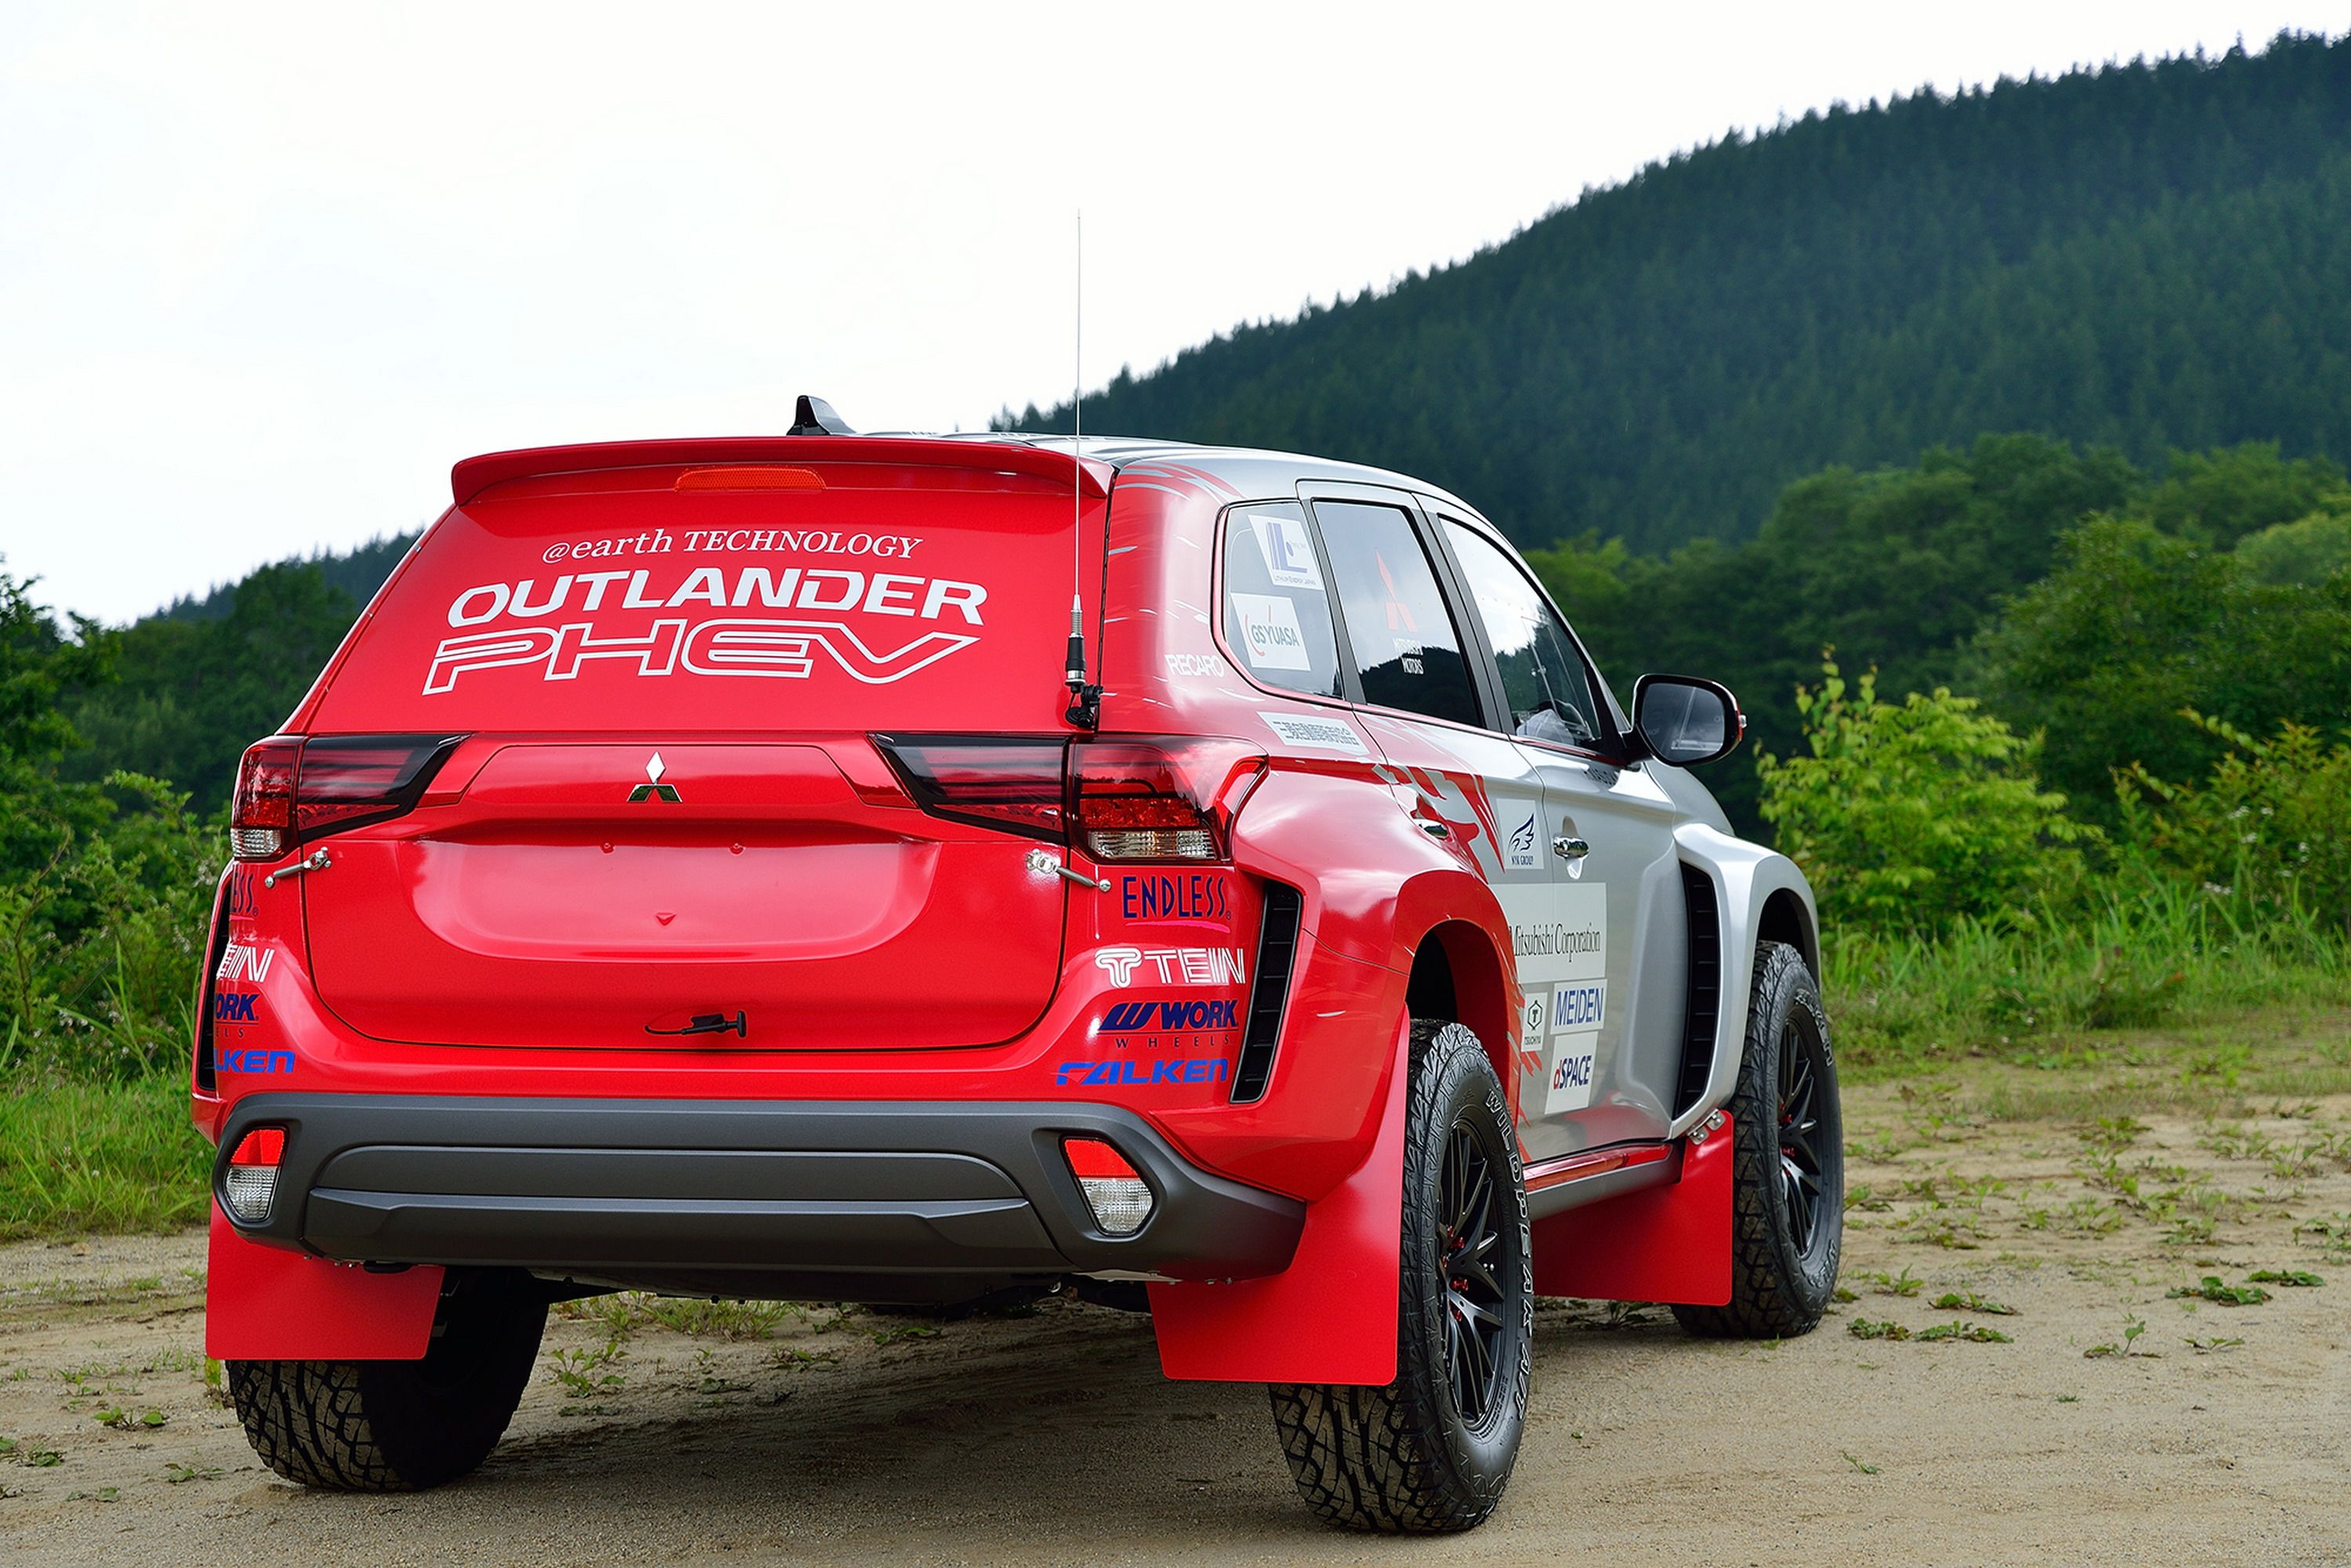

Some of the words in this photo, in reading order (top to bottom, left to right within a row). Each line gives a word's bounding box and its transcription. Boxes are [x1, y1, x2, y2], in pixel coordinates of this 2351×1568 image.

[542, 528, 672, 563] @earth
[683, 529, 923, 559] TECHNOLOGY
[447, 567, 988, 627] OUTLANDER
[422, 618, 982, 696] PHEV
[1165, 654, 1225, 678] RECARO
[1122, 875, 1226, 918] ENDLESS
[1555, 922, 1600, 963] Corporation
[1143, 947, 1246, 984] TEIN
[1161, 1000, 1238, 1030] WORK
[1555, 987, 1603, 1026] MEIDEN
[1115, 1036, 1229, 1048] WHEELS
[1053, 1058, 1228, 1085] FALKEN
[1553, 1056, 1592, 1090] dSPACE
